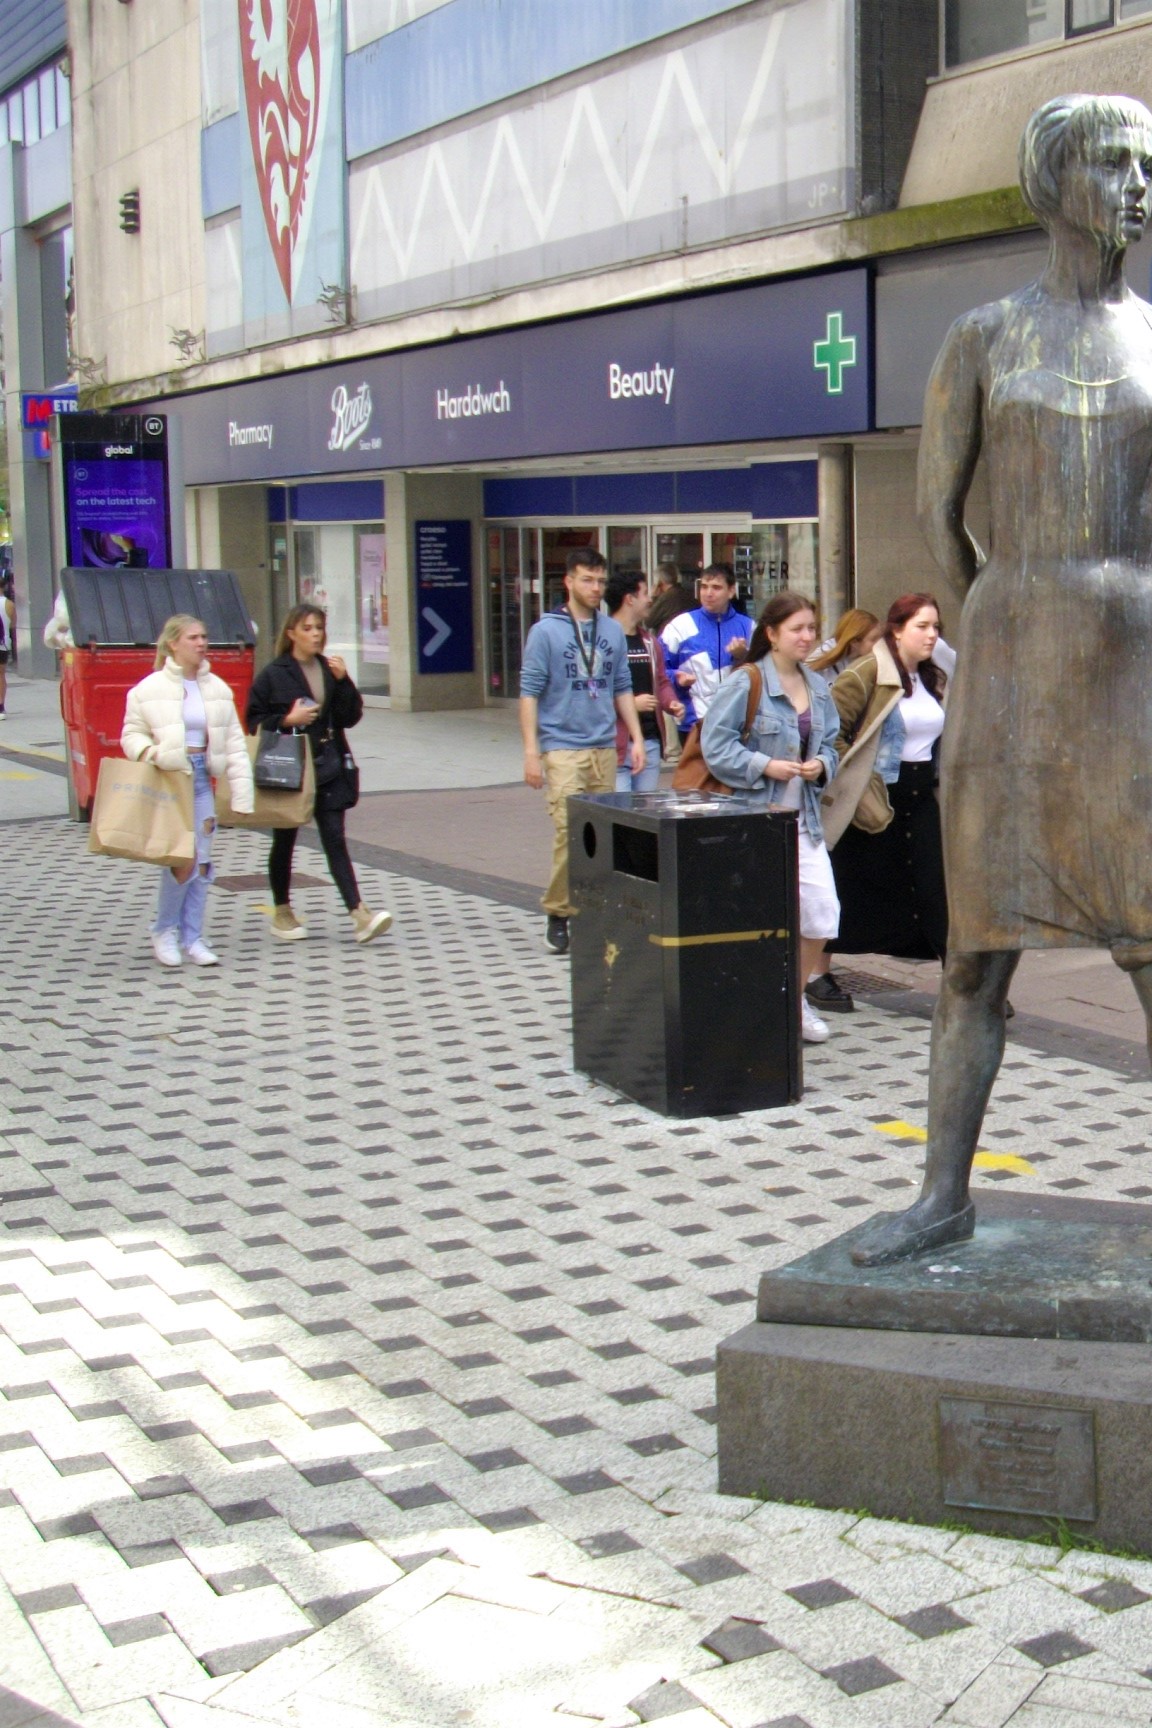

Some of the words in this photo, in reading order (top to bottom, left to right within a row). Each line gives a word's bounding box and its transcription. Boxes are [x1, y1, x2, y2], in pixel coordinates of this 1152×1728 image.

[609, 361, 675, 404] Beauty
[27, 398, 79, 424] METR
[436, 380, 511, 420] Harddwch
[328, 381, 373, 452] Boots
[228, 421, 274, 450] Pharmacy
[104, 445, 134, 458] global
[76, 498, 89, 506] on
[89, 497, 106, 506] the
[106, 496, 135, 506] latest
[135, 496, 157, 506] tech
